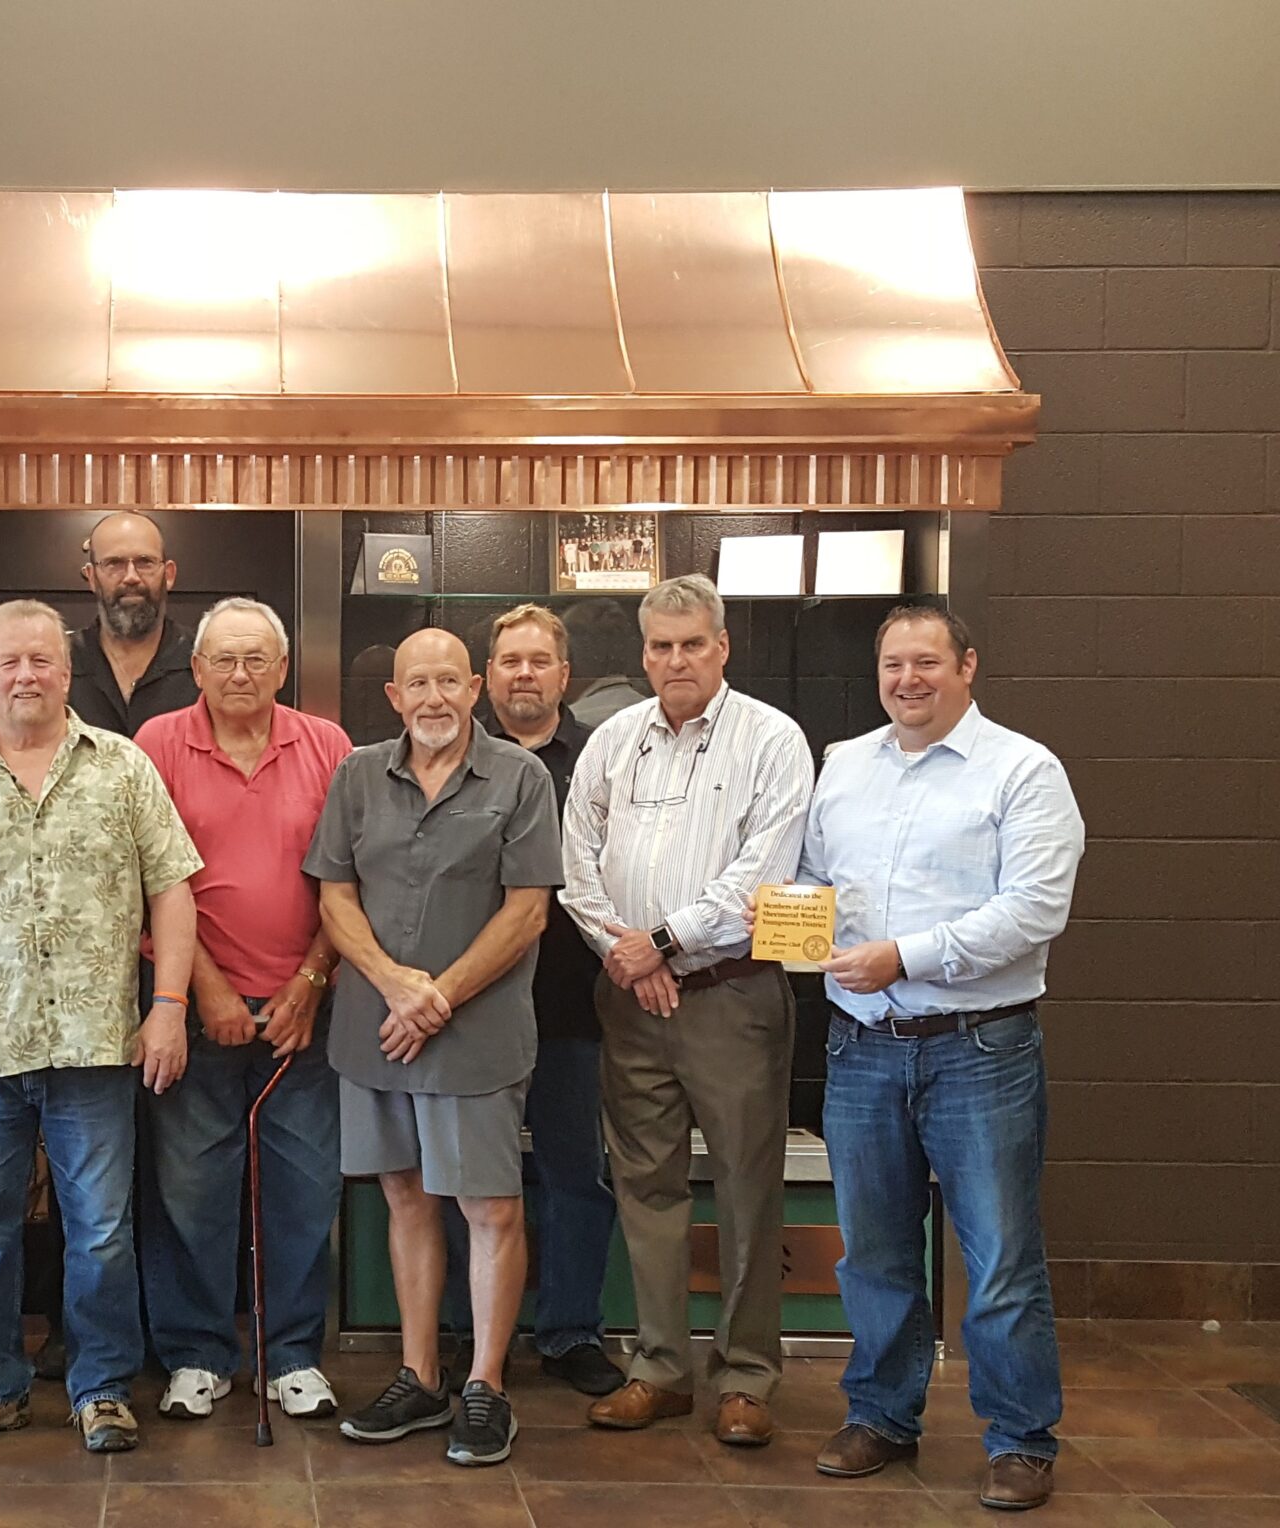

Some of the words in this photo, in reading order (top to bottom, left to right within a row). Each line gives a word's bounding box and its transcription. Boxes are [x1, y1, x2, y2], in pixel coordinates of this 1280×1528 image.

[770, 890, 802, 899] Dedicated
[763, 902, 792, 910] Members
[800, 912, 827, 920] Workers
[762, 919, 801, 927] Youngstown
[802, 921, 827, 929] District
